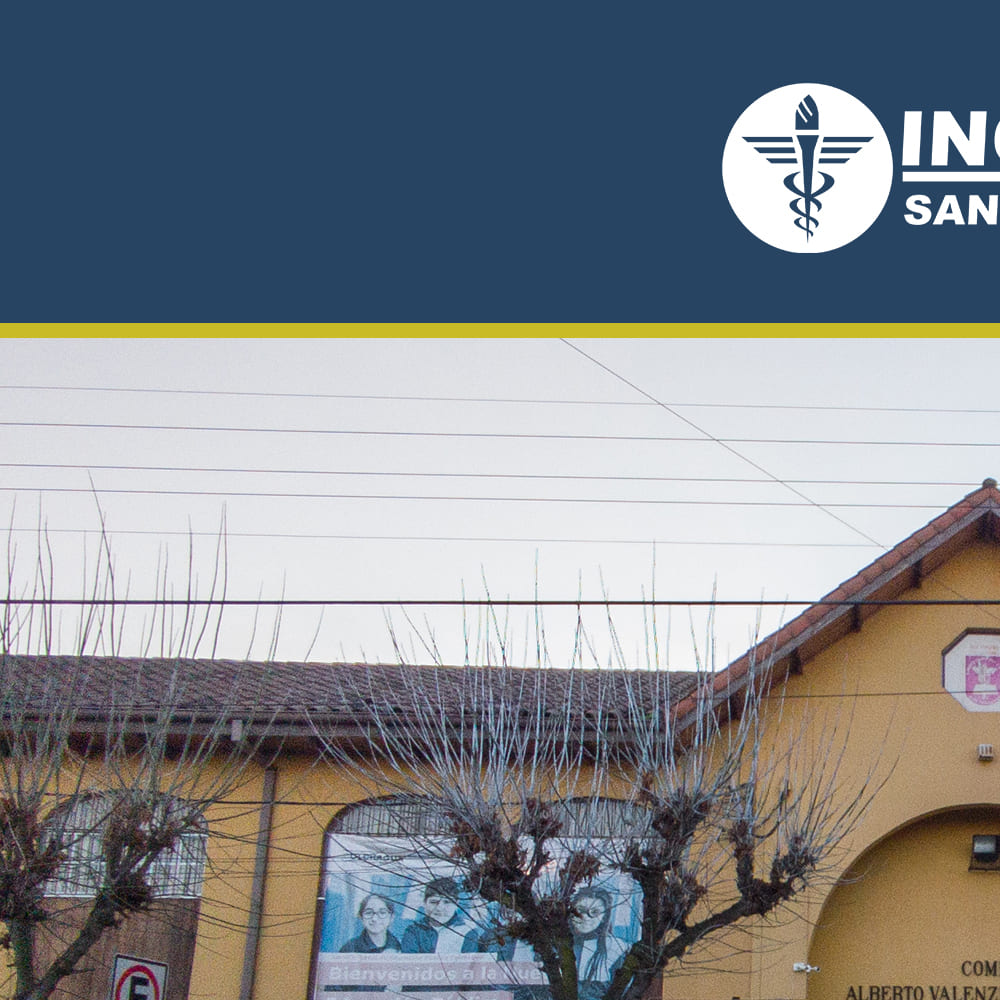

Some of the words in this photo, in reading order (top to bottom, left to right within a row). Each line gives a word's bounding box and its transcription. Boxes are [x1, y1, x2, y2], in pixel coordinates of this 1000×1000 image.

[329, 965, 457, 981] Bienvenidos
[463, 969, 475, 981] a
[482, 966, 497, 981] la
